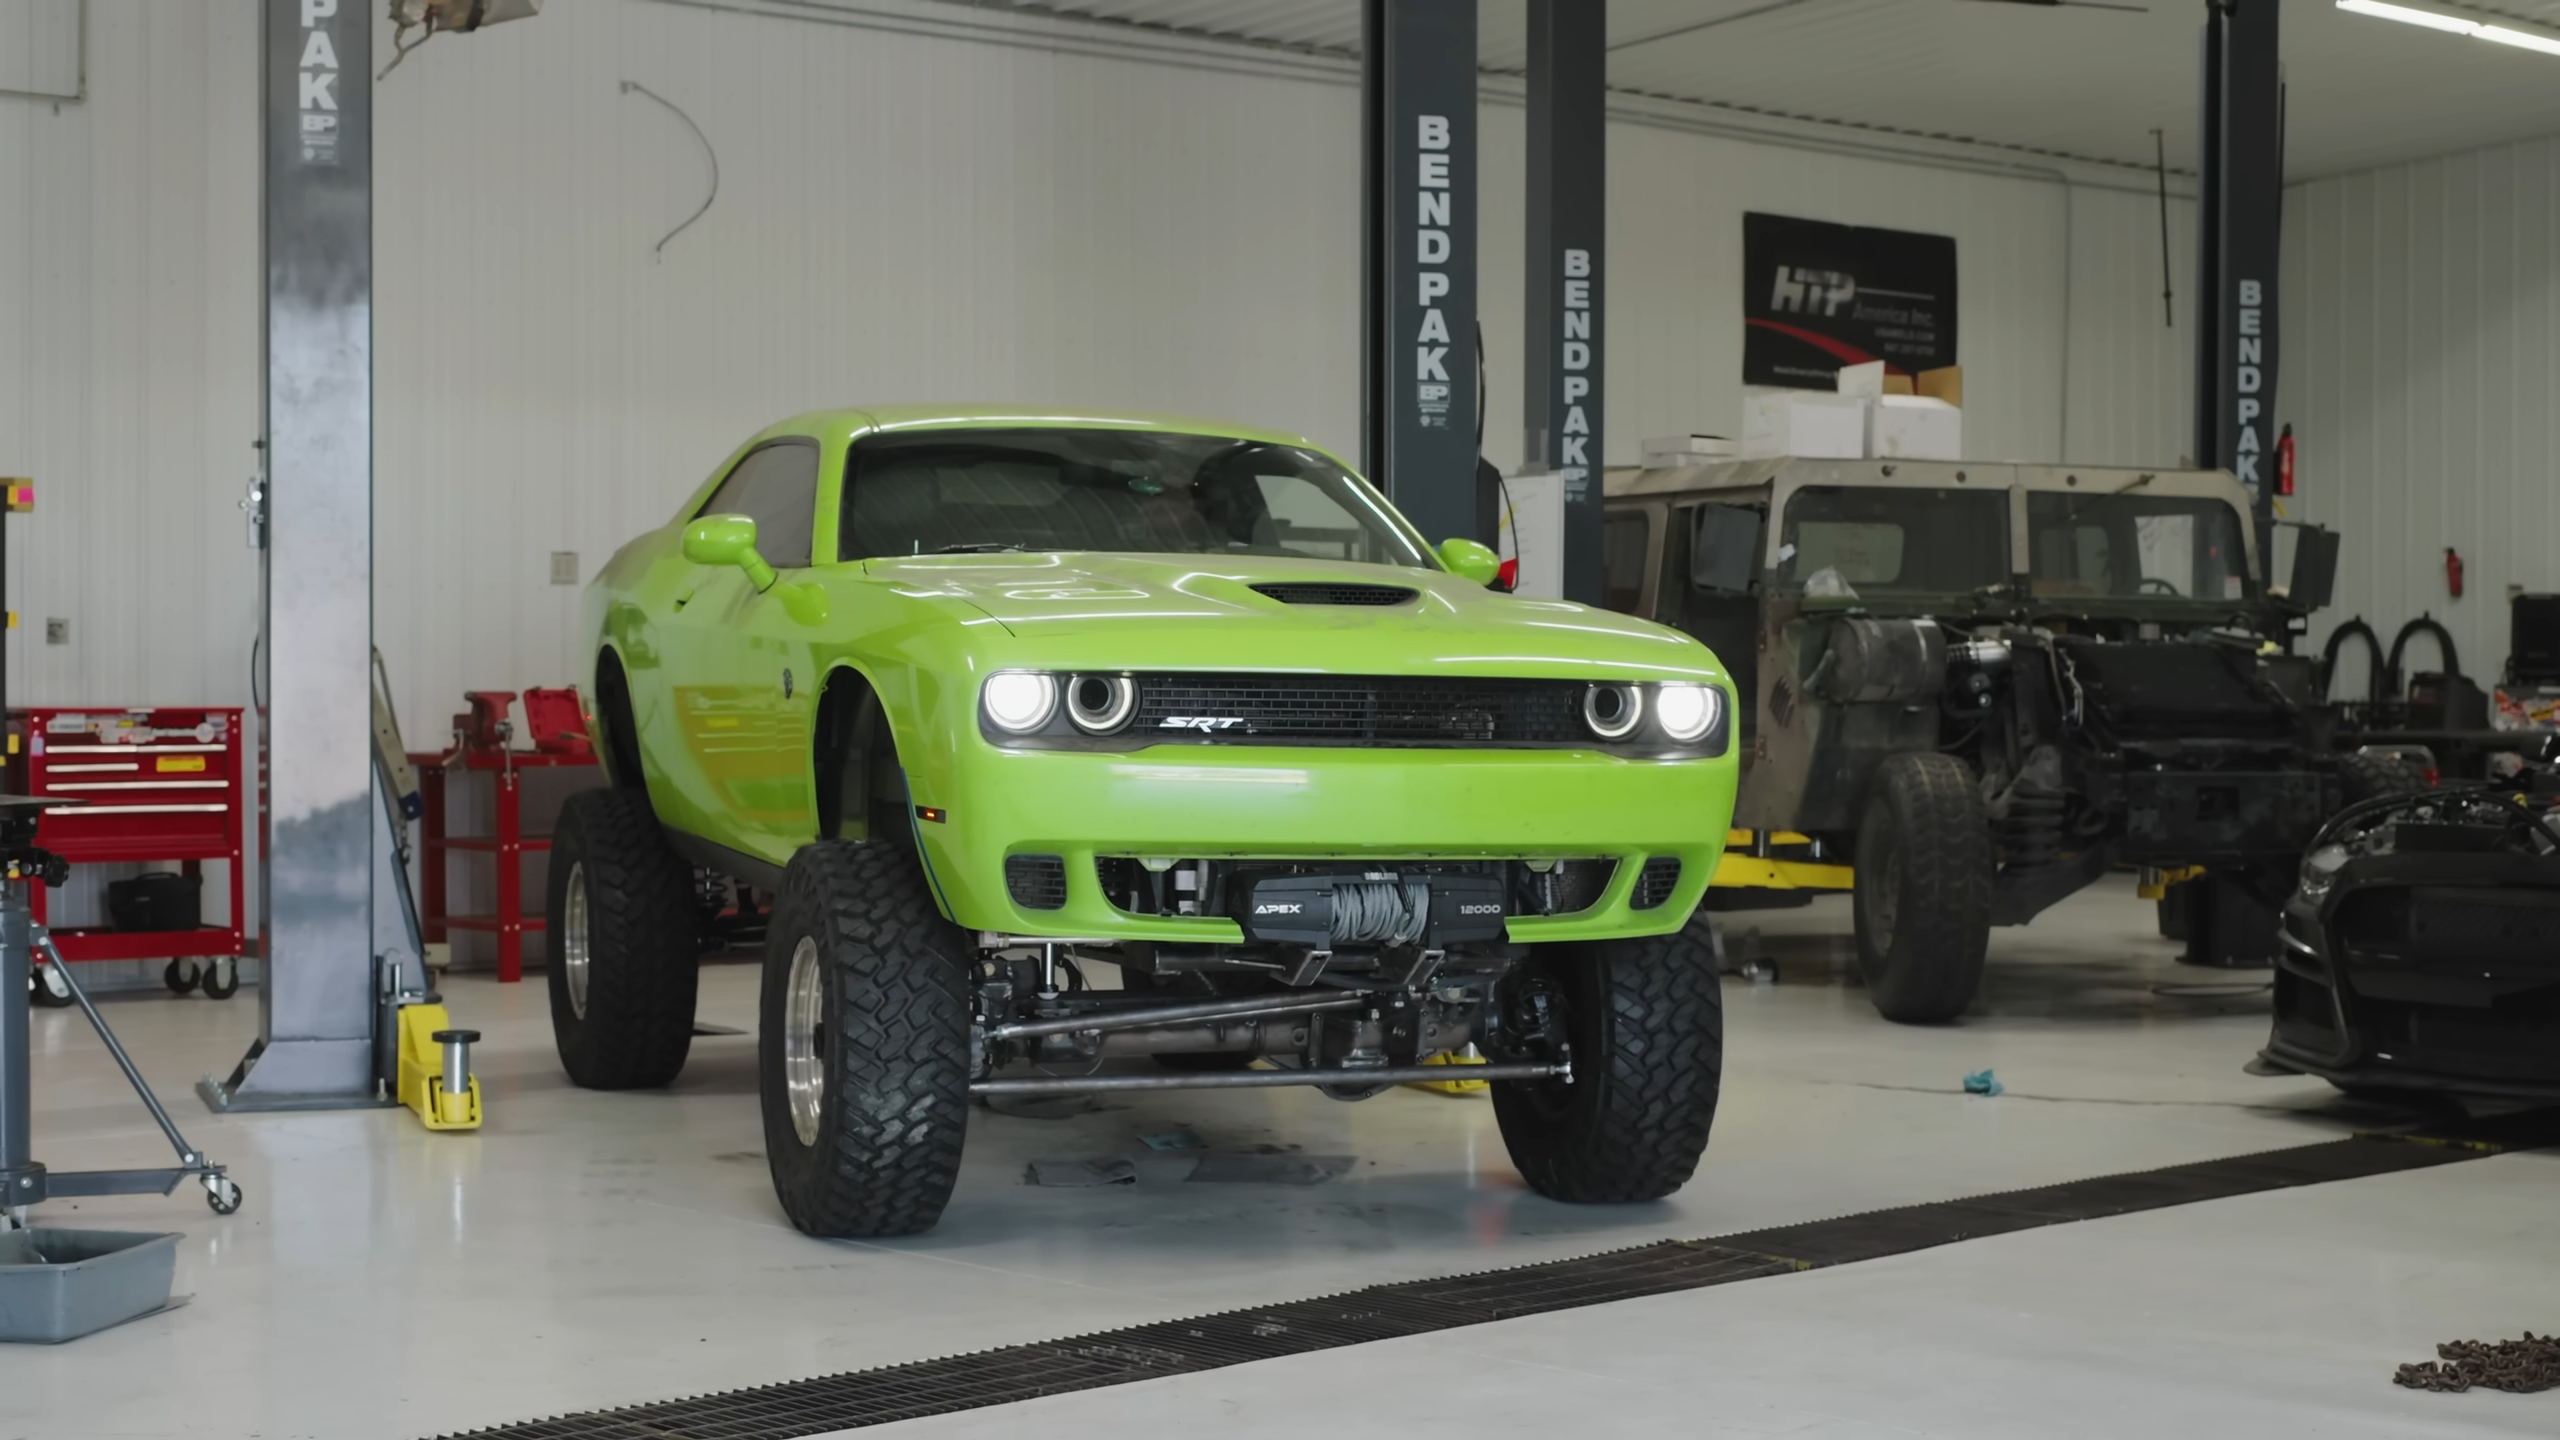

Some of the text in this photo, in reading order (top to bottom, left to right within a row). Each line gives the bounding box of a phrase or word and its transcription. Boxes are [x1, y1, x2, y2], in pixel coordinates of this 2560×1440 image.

[302, 115, 336, 131] BP
[1417, 115, 1450, 381] BENDPAK
[1771, 265, 1856, 317] HTP
[1852, 302, 1909, 325] America
[1562, 249, 1589, 465] BENDPAK
[2237, 280, 2261, 481] BENDPAK
[1420, 385, 1448, 400] BP
[1159, 716, 1244, 733] SRT
[1255, 904, 1301, 914] APEX
[1460, 904, 1501, 914] 12000
